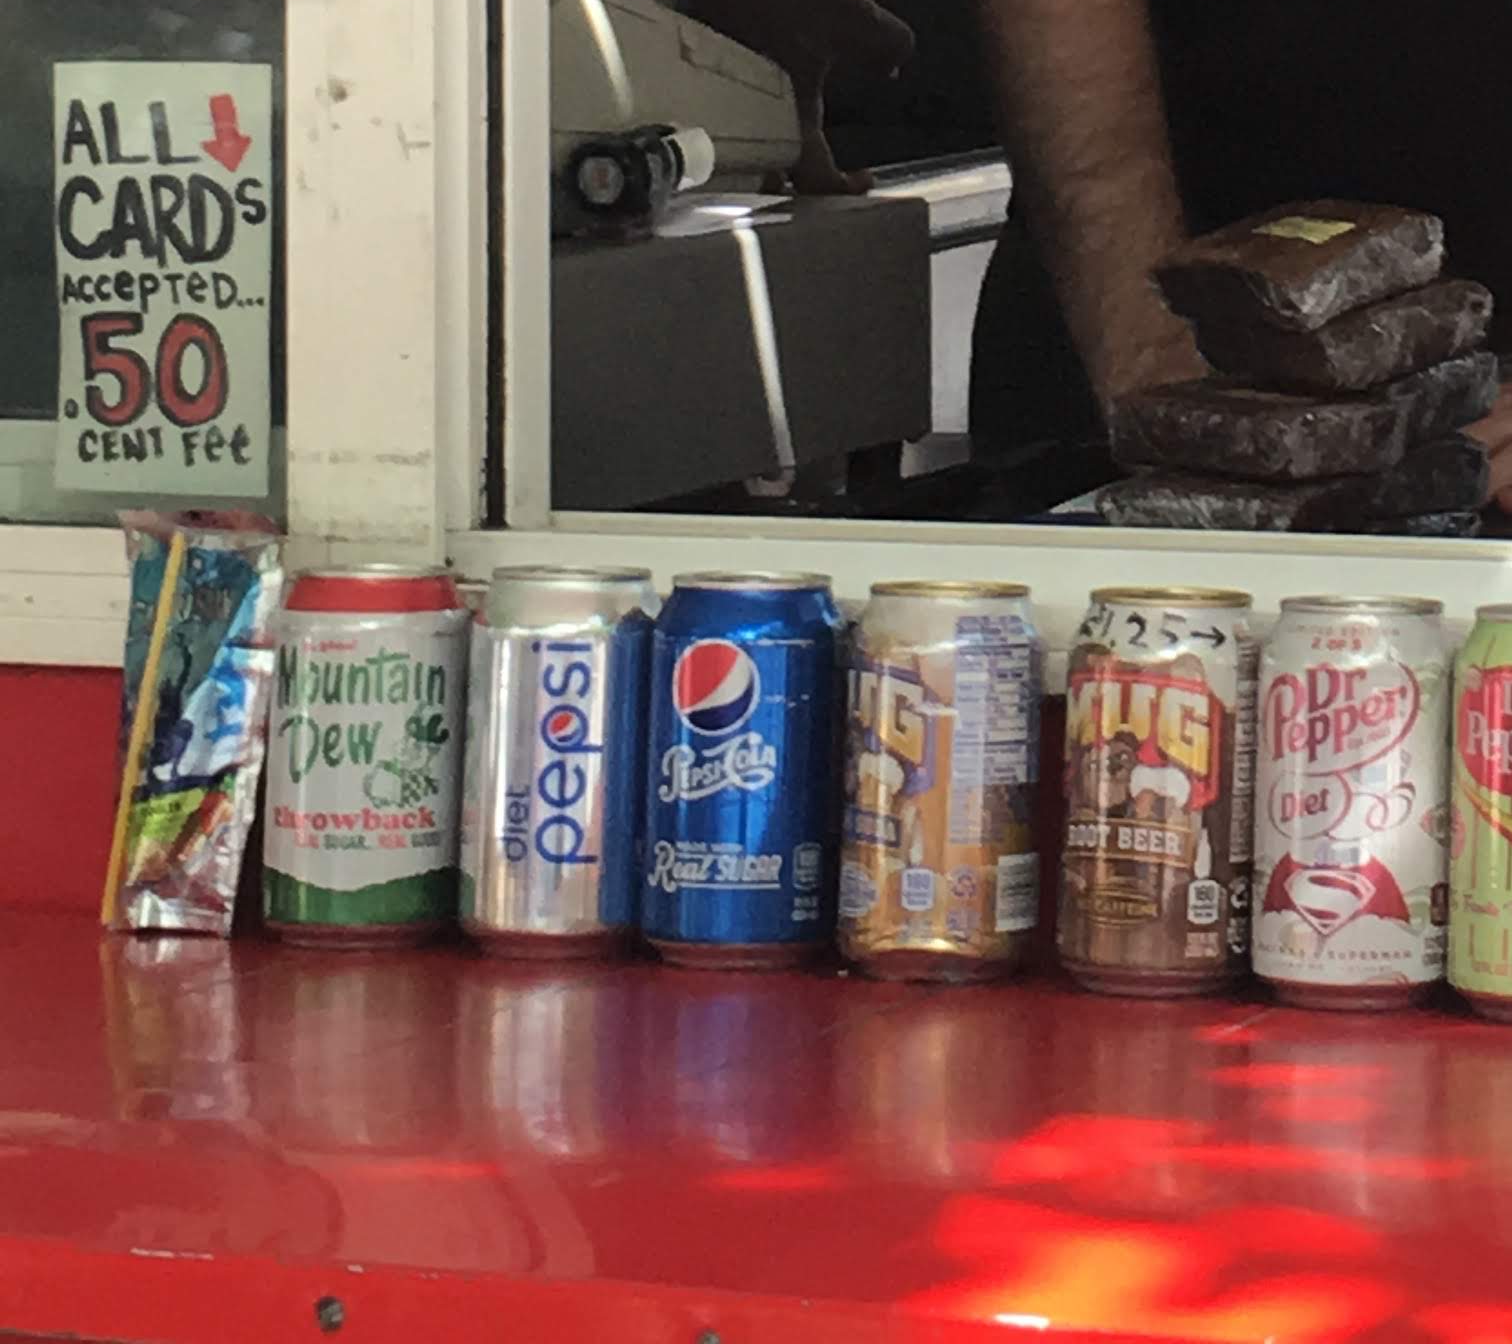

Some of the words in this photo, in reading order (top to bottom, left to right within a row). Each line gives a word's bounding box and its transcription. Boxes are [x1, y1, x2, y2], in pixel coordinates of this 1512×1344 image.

[62, 98, 201, 166] ALL
[277, 644, 446, 709] Mountain
[1306, 662, 1367, 714] Dr
[278, 714, 383, 784] Dew
[1265, 672, 1408, 763] Pepper
[532, 641, 602, 864] pepsi
[273, 805, 437, 831] throwback
[500, 784, 531, 863] diet
[1280, 788, 1331, 822] Diet
[1117, 826, 1183, 856] BEER
